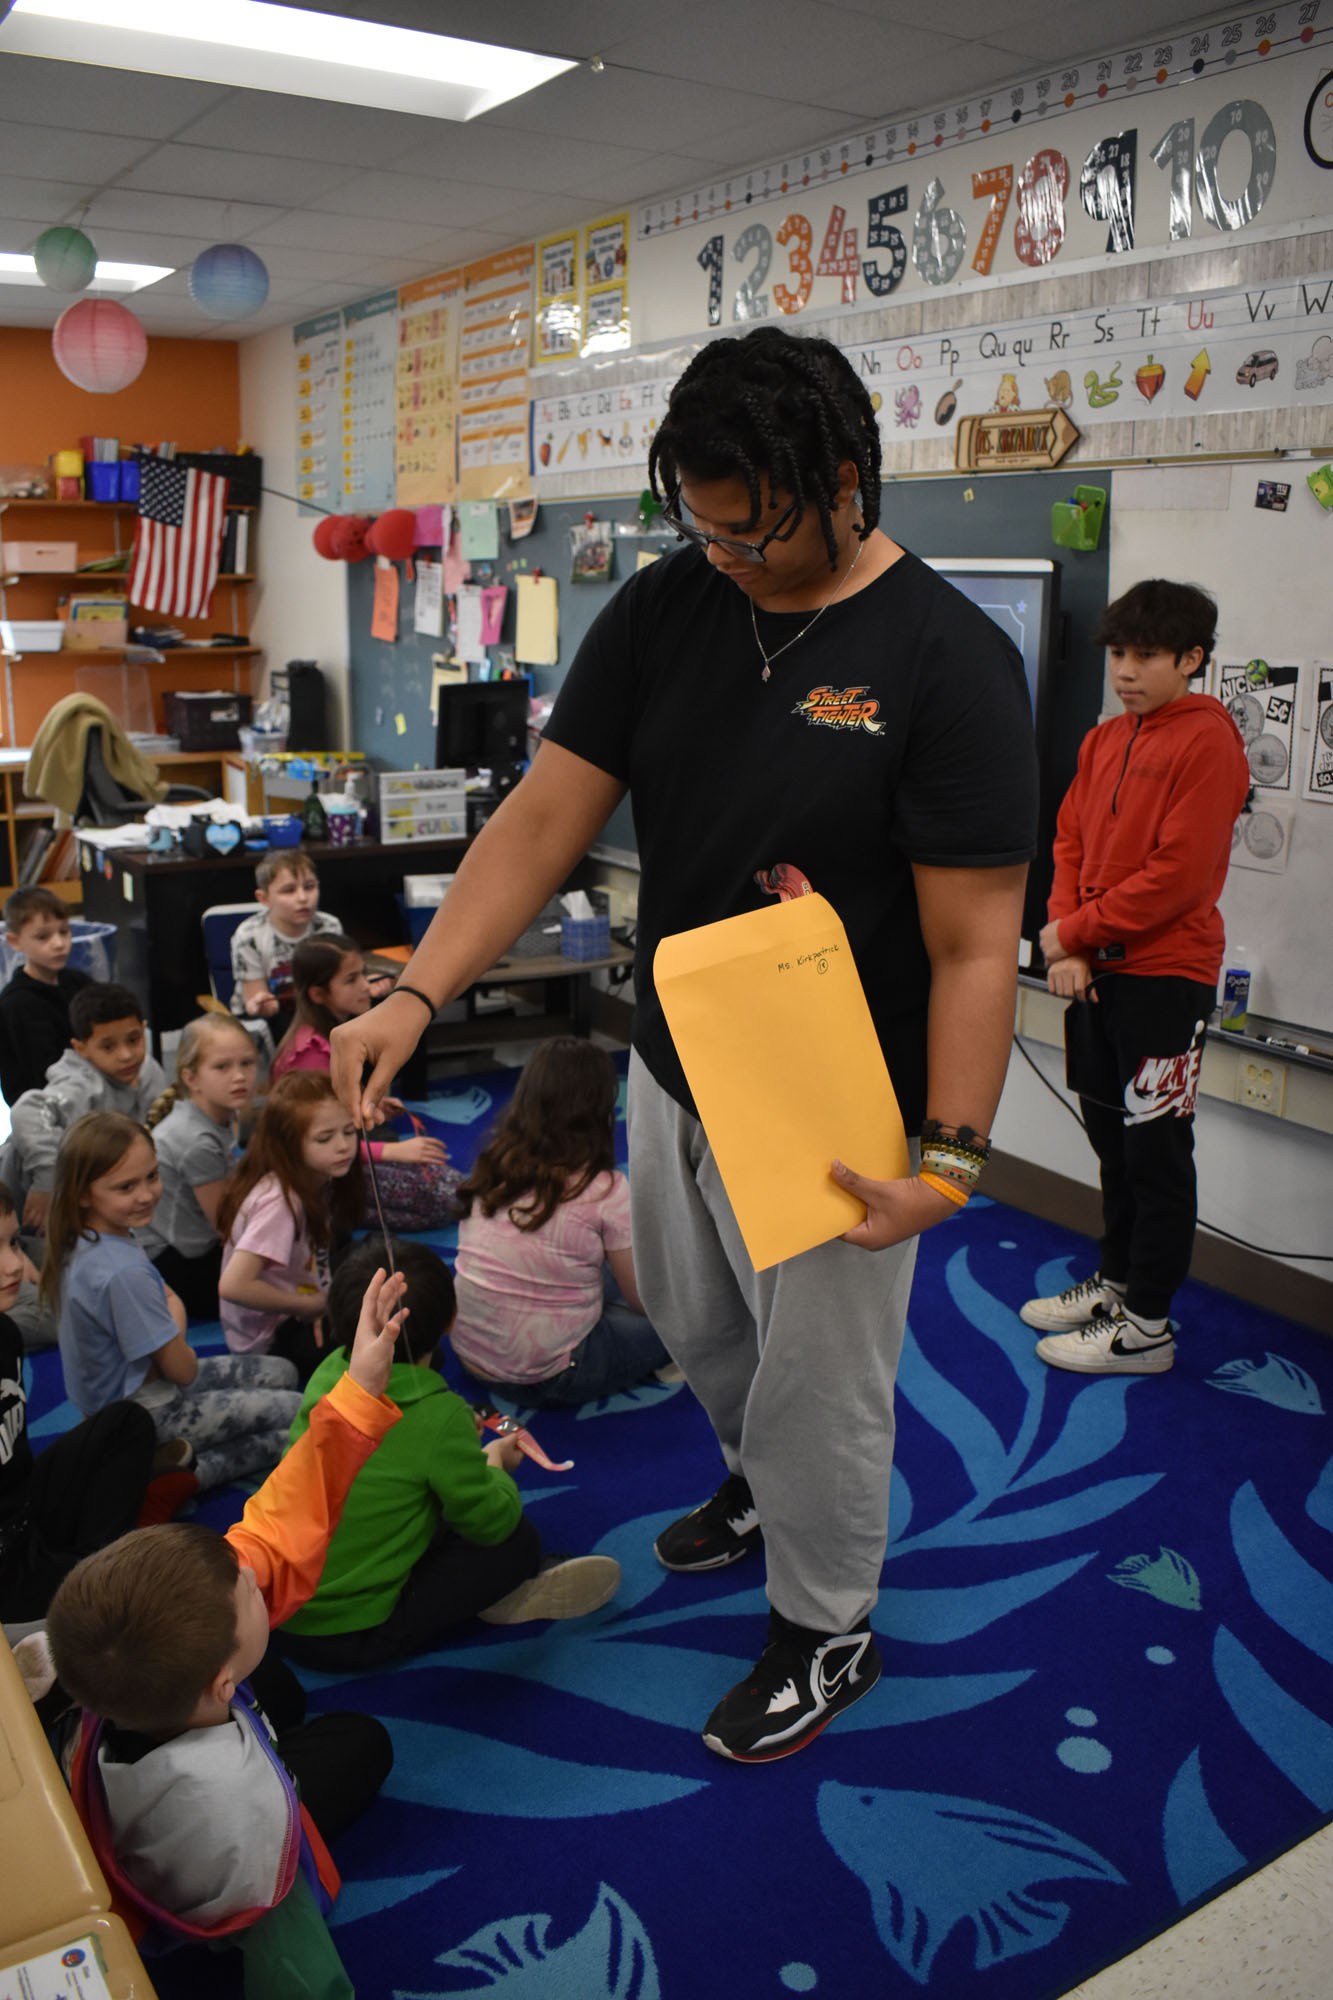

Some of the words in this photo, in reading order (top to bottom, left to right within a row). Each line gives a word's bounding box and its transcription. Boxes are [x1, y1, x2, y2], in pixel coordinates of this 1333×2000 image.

[980, 99, 992, 117] 17
[1011, 87, 1024, 106] 18
[1037, 79, 1050, 98] 19
[1061, 69, 1079, 91] 20
[1097, 60, 1112, 81] 21
[1124, 52, 1143, 74] 22
[1154, 46, 1172, 67] 23
[1190, 33, 1209, 56] 24
[1222, 24, 1242, 46] 25
[1255, 13, 1276, 37] 26
[1298, 1, 1320, 24] 27
[697, 235, 723, 326] 1
[733, 223, 772, 321] 2
[773, 214, 813, 315] 3
[815, 204, 860, 303] 4
[863, 184, 908, 297] 5
[912, 177, 967, 286] 6
[972, 164, 1013, 276] 7
[1014, 149, 1070, 266] 8
[1080, 128, 1137, 253] 9
[1149, 99, 1276, 241] 10
[860, 350, 881, 376] Nn
[896, 345, 922, 371] Oo
[940, 338, 959, 376] Pp
[979, 331, 1006, 359] Qu
[1013, 339, 1032, 367] qu
[1049, 321, 1070, 350] Rr
[1093, 314, 1114, 344] Ss
[1137, 306, 1160, 337] Tt
[1187, 299, 1214, 331] Uu
[1245, 290, 1276, 323] Vv
[1302, 280, 1333, 316] W
[799, 687, 865, 710] STREET
[807, 701, 883, 733] FIGHTER
